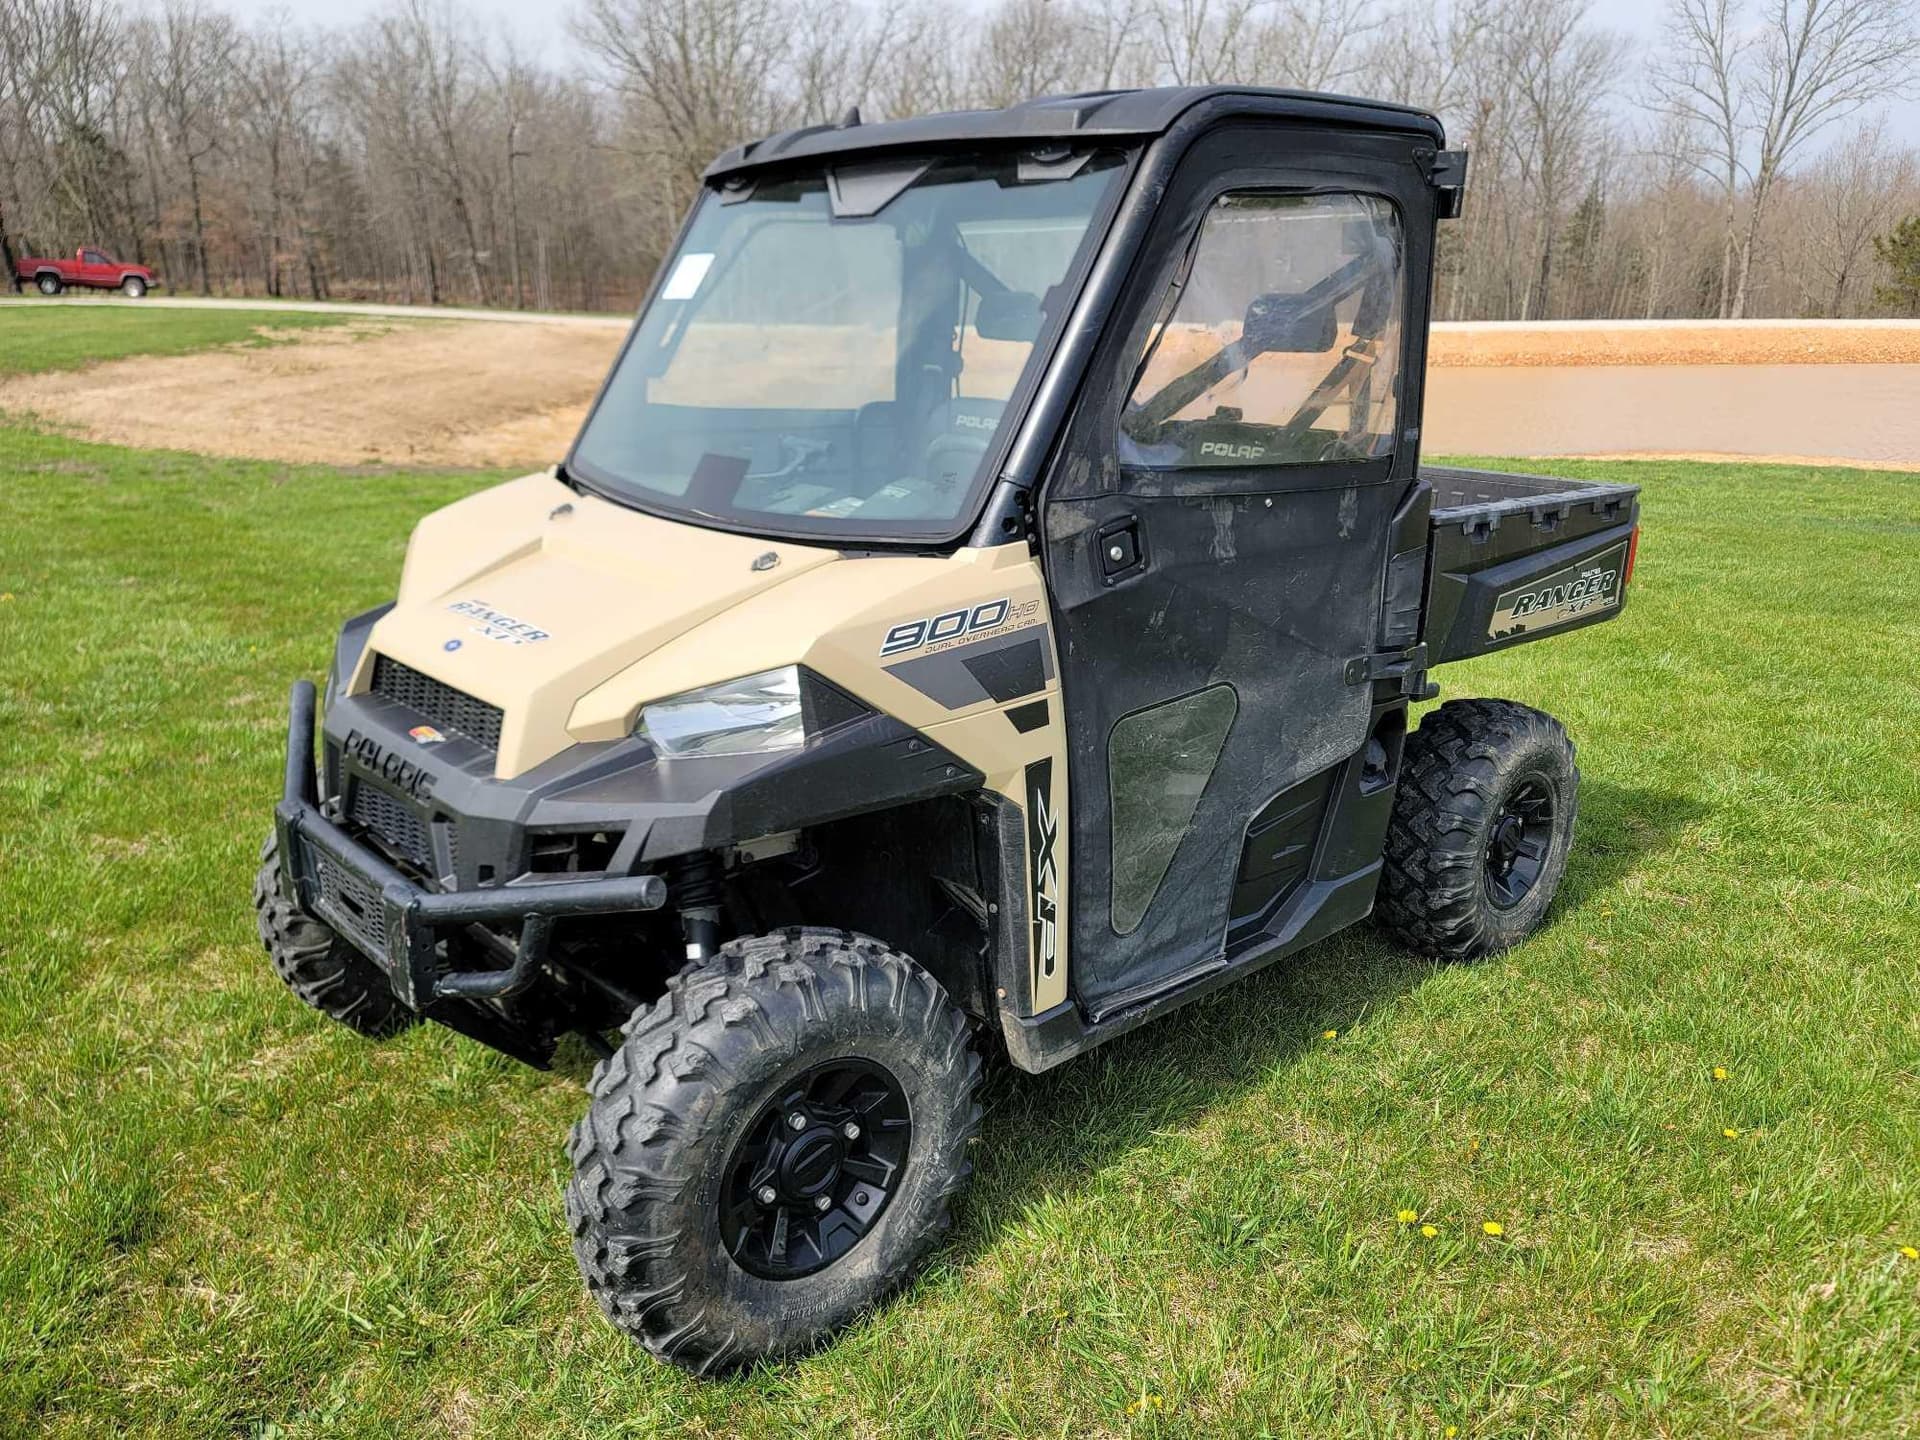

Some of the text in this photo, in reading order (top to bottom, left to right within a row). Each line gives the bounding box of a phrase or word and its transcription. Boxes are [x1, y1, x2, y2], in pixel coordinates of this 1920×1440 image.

[1511, 570, 1616, 618] RANGER
[449, 601, 550, 642] RANGER
[879, 598, 1010, 656] 900
[925, 641, 954, 654] DUAL
[958, 624, 1015, 645] OVERHEAD
[343, 730, 439, 802] POLARIS
[1037, 787, 1059, 979] XP
